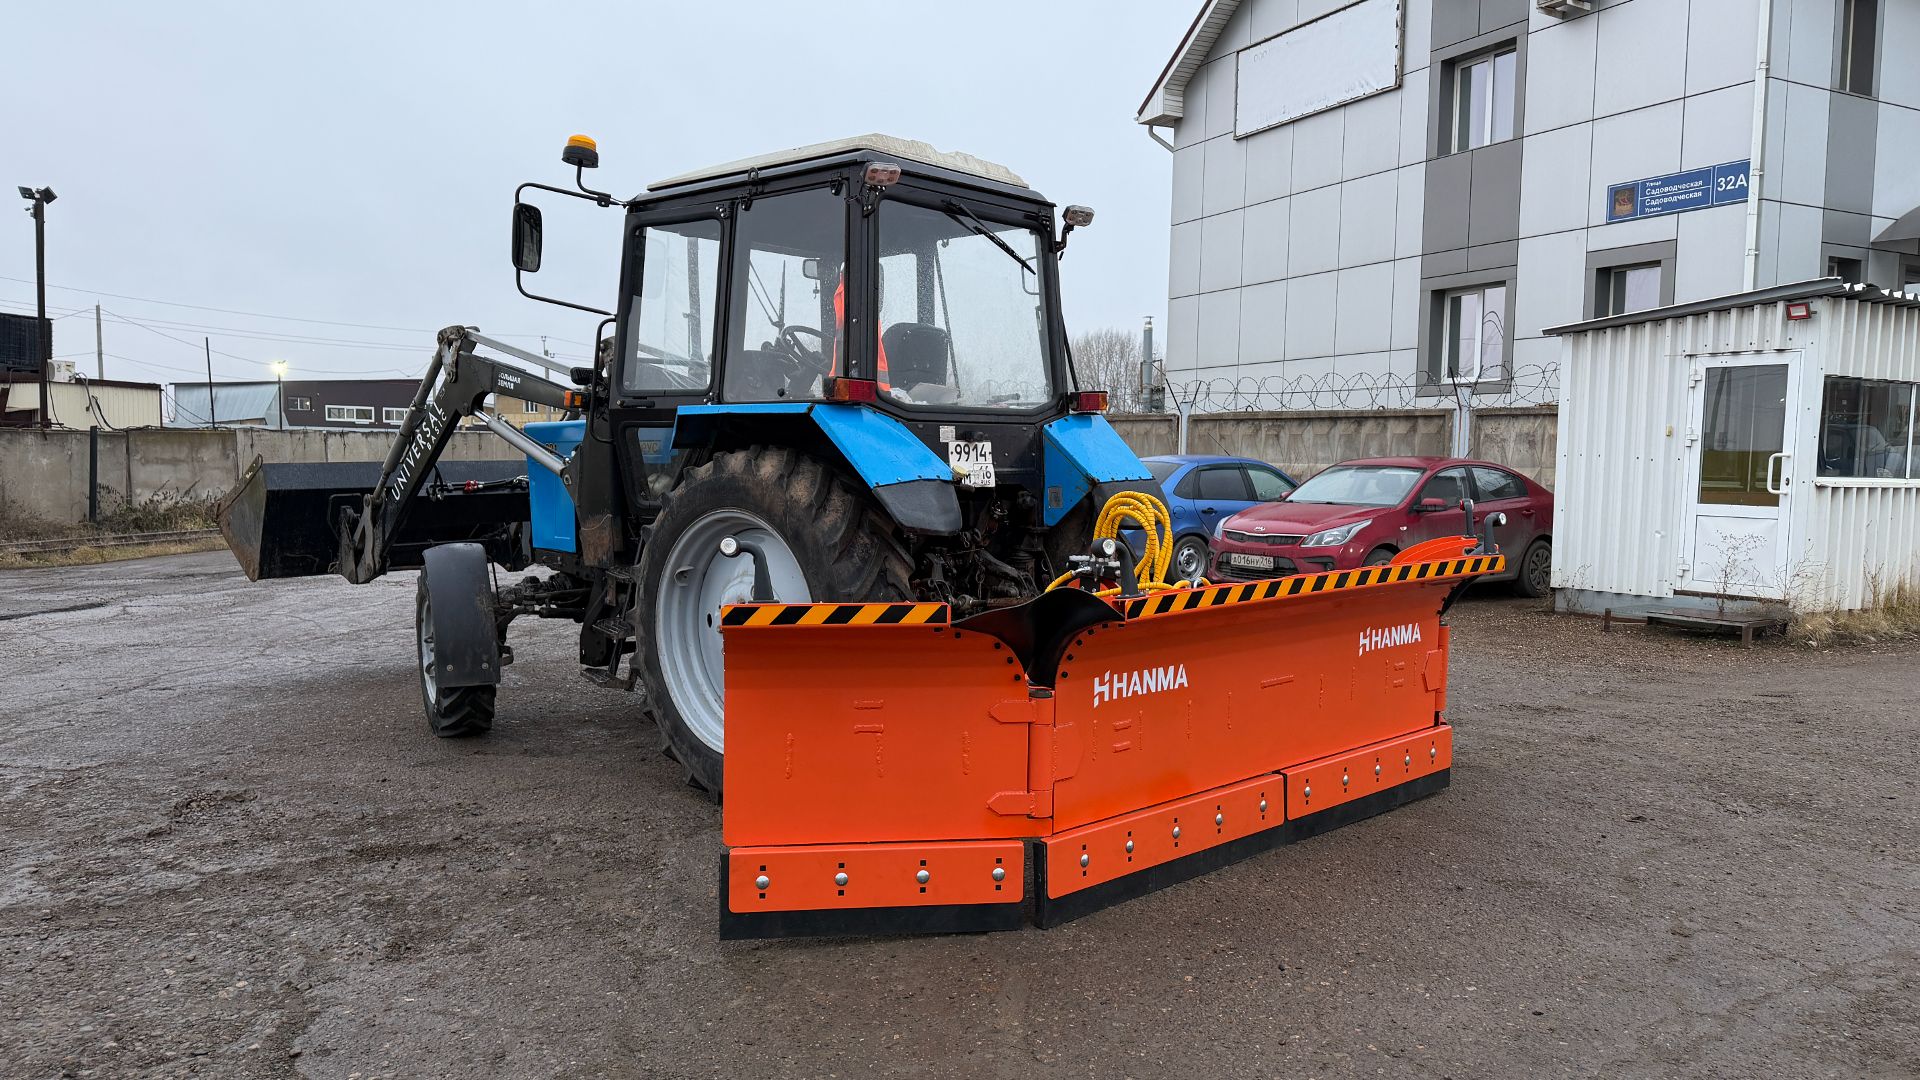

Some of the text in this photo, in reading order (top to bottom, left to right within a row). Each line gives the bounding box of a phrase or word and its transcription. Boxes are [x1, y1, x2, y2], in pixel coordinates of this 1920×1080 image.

[1645, 180, 1703, 196] Садоводческая
[1717, 173, 1748, 192] 32А
[1645, 191, 1702, 206] Садоводческая
[426, 412, 448, 451] BASIC
[391, 401, 443, 502] UNIVERSAL
[954, 443, 987, 462] 9914
[1371, 622, 1422, 651] HANMA
[1112, 663, 1189, 700] HANMA
